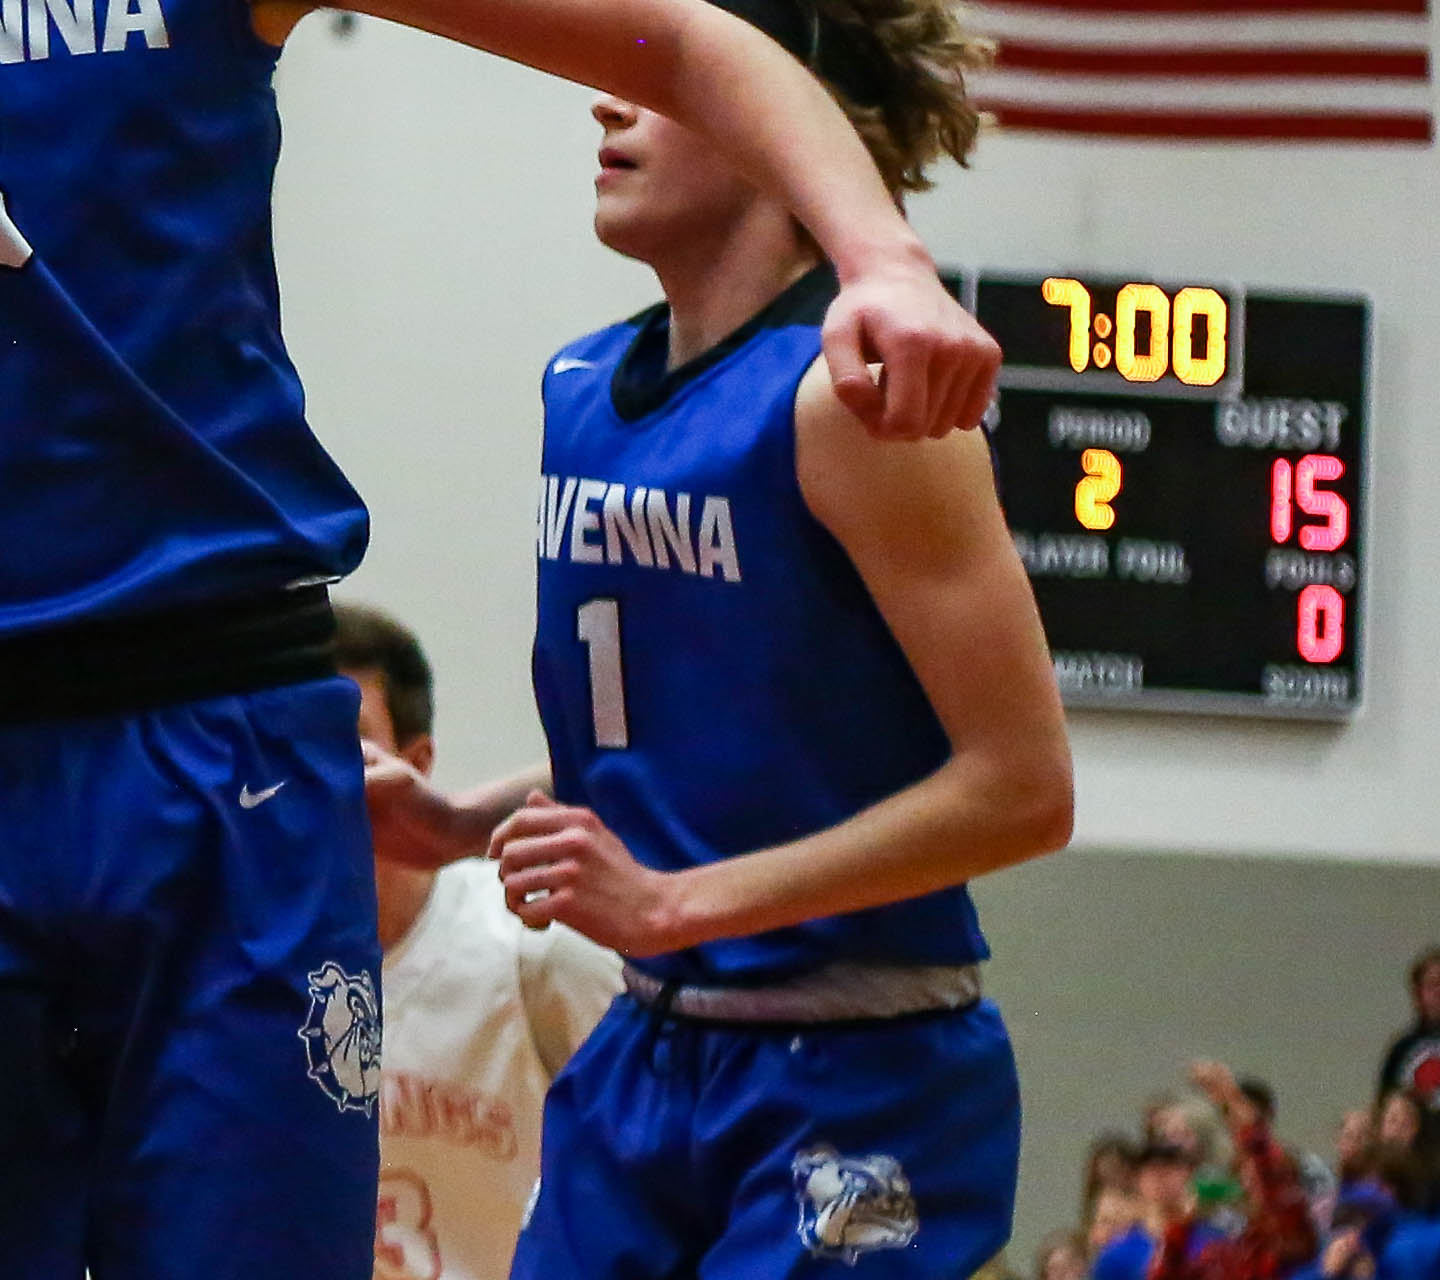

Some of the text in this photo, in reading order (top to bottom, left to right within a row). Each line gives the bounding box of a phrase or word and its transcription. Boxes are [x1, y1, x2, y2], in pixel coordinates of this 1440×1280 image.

[1041, 277, 1228, 386] 7:00
[1216, 397, 1345, 450] GUEST
[1075, 449, 1122, 530] 2
[1271, 454, 1349, 551] 15
[1296, 584, 1344, 663] 0
[577, 599, 629, 749] 1
